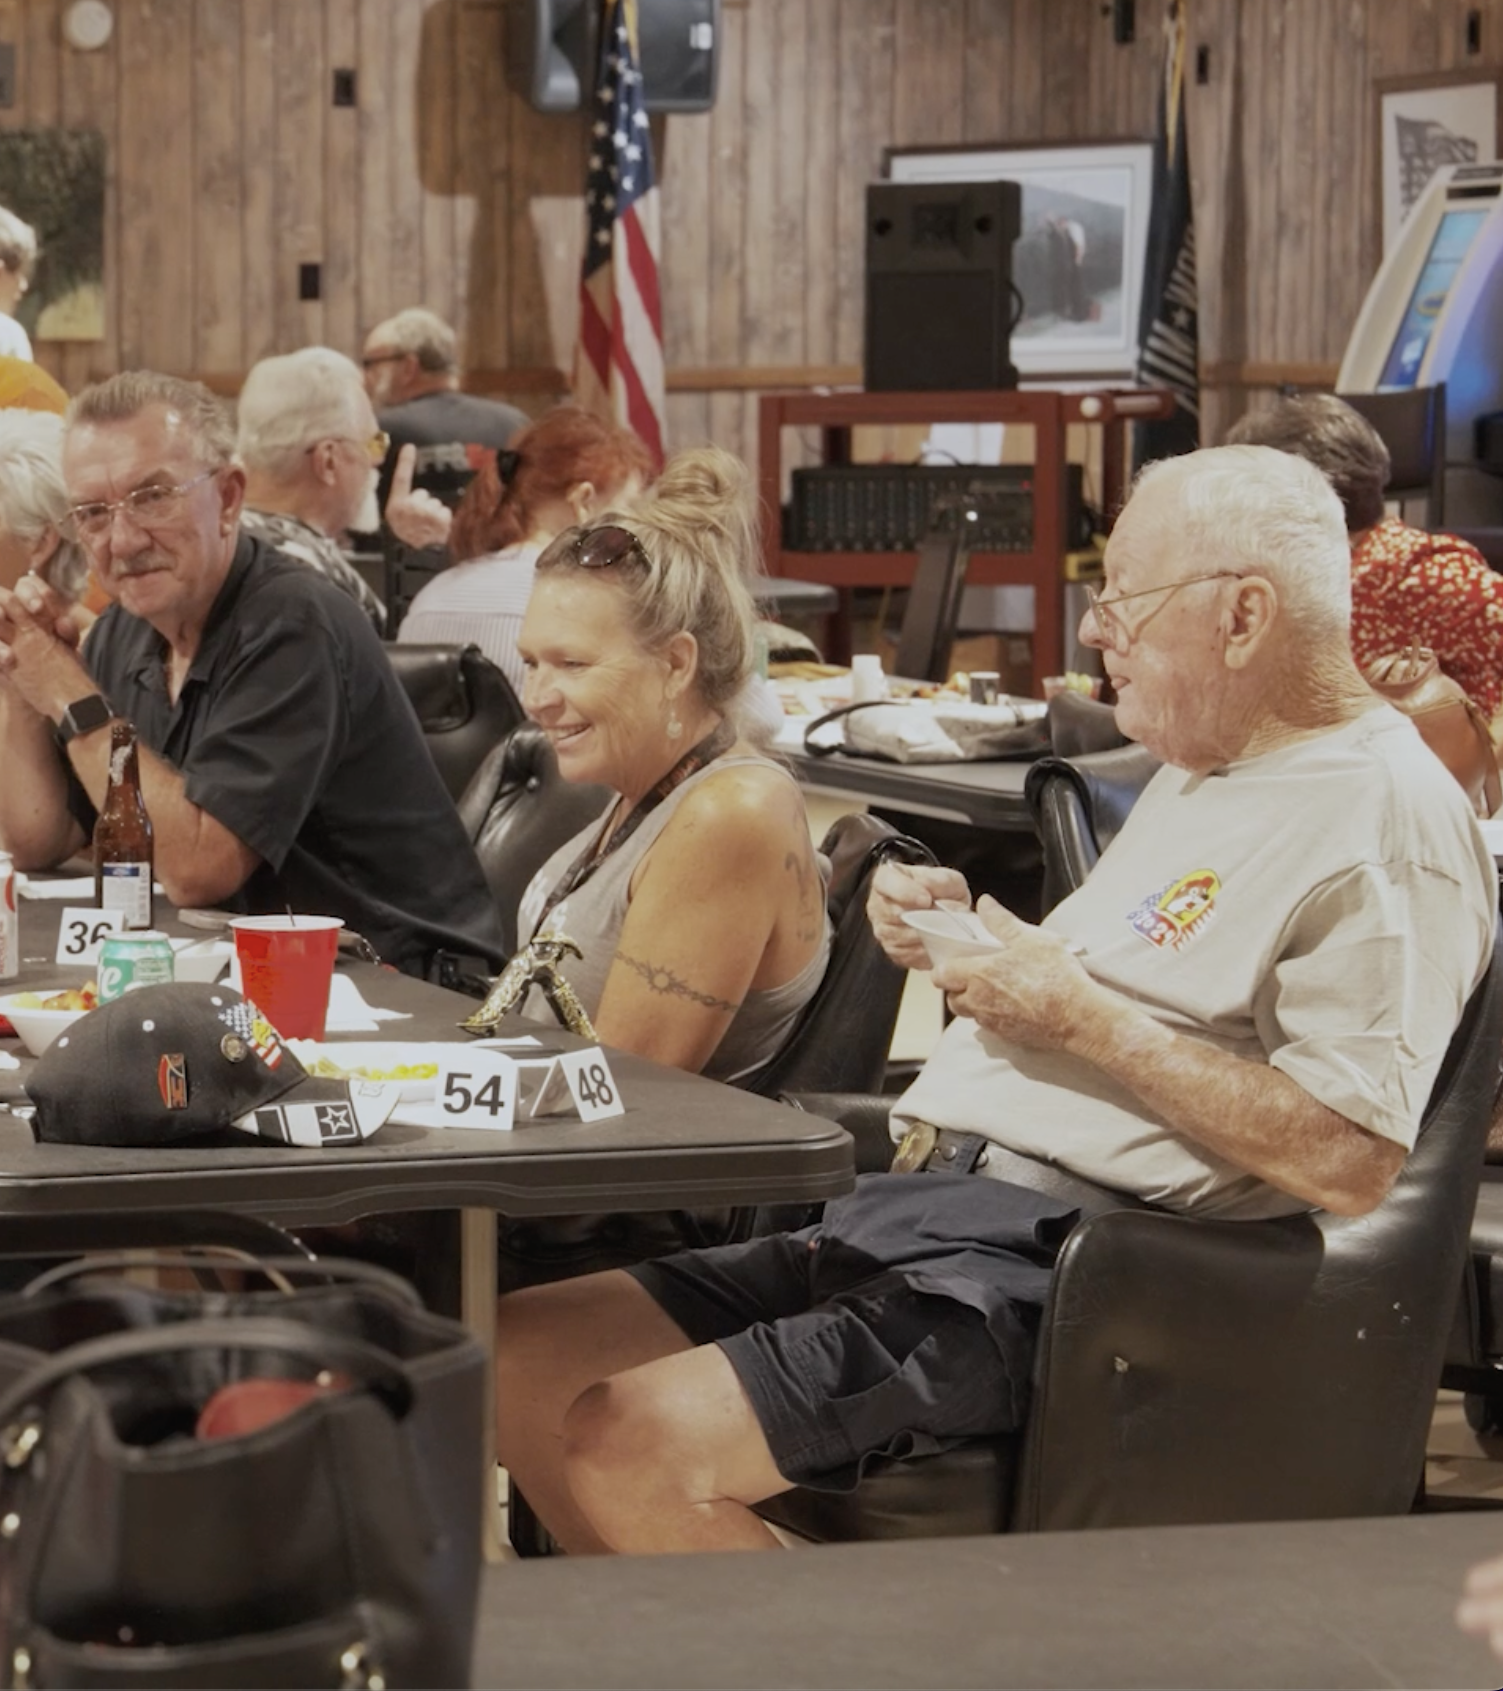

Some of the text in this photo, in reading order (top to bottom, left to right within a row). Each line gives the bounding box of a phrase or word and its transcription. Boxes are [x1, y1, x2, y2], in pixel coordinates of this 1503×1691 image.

[66, 921, 113, 955] 36
[443, 1072, 504, 1116] 54
[578, 1064, 613, 1108] 48
